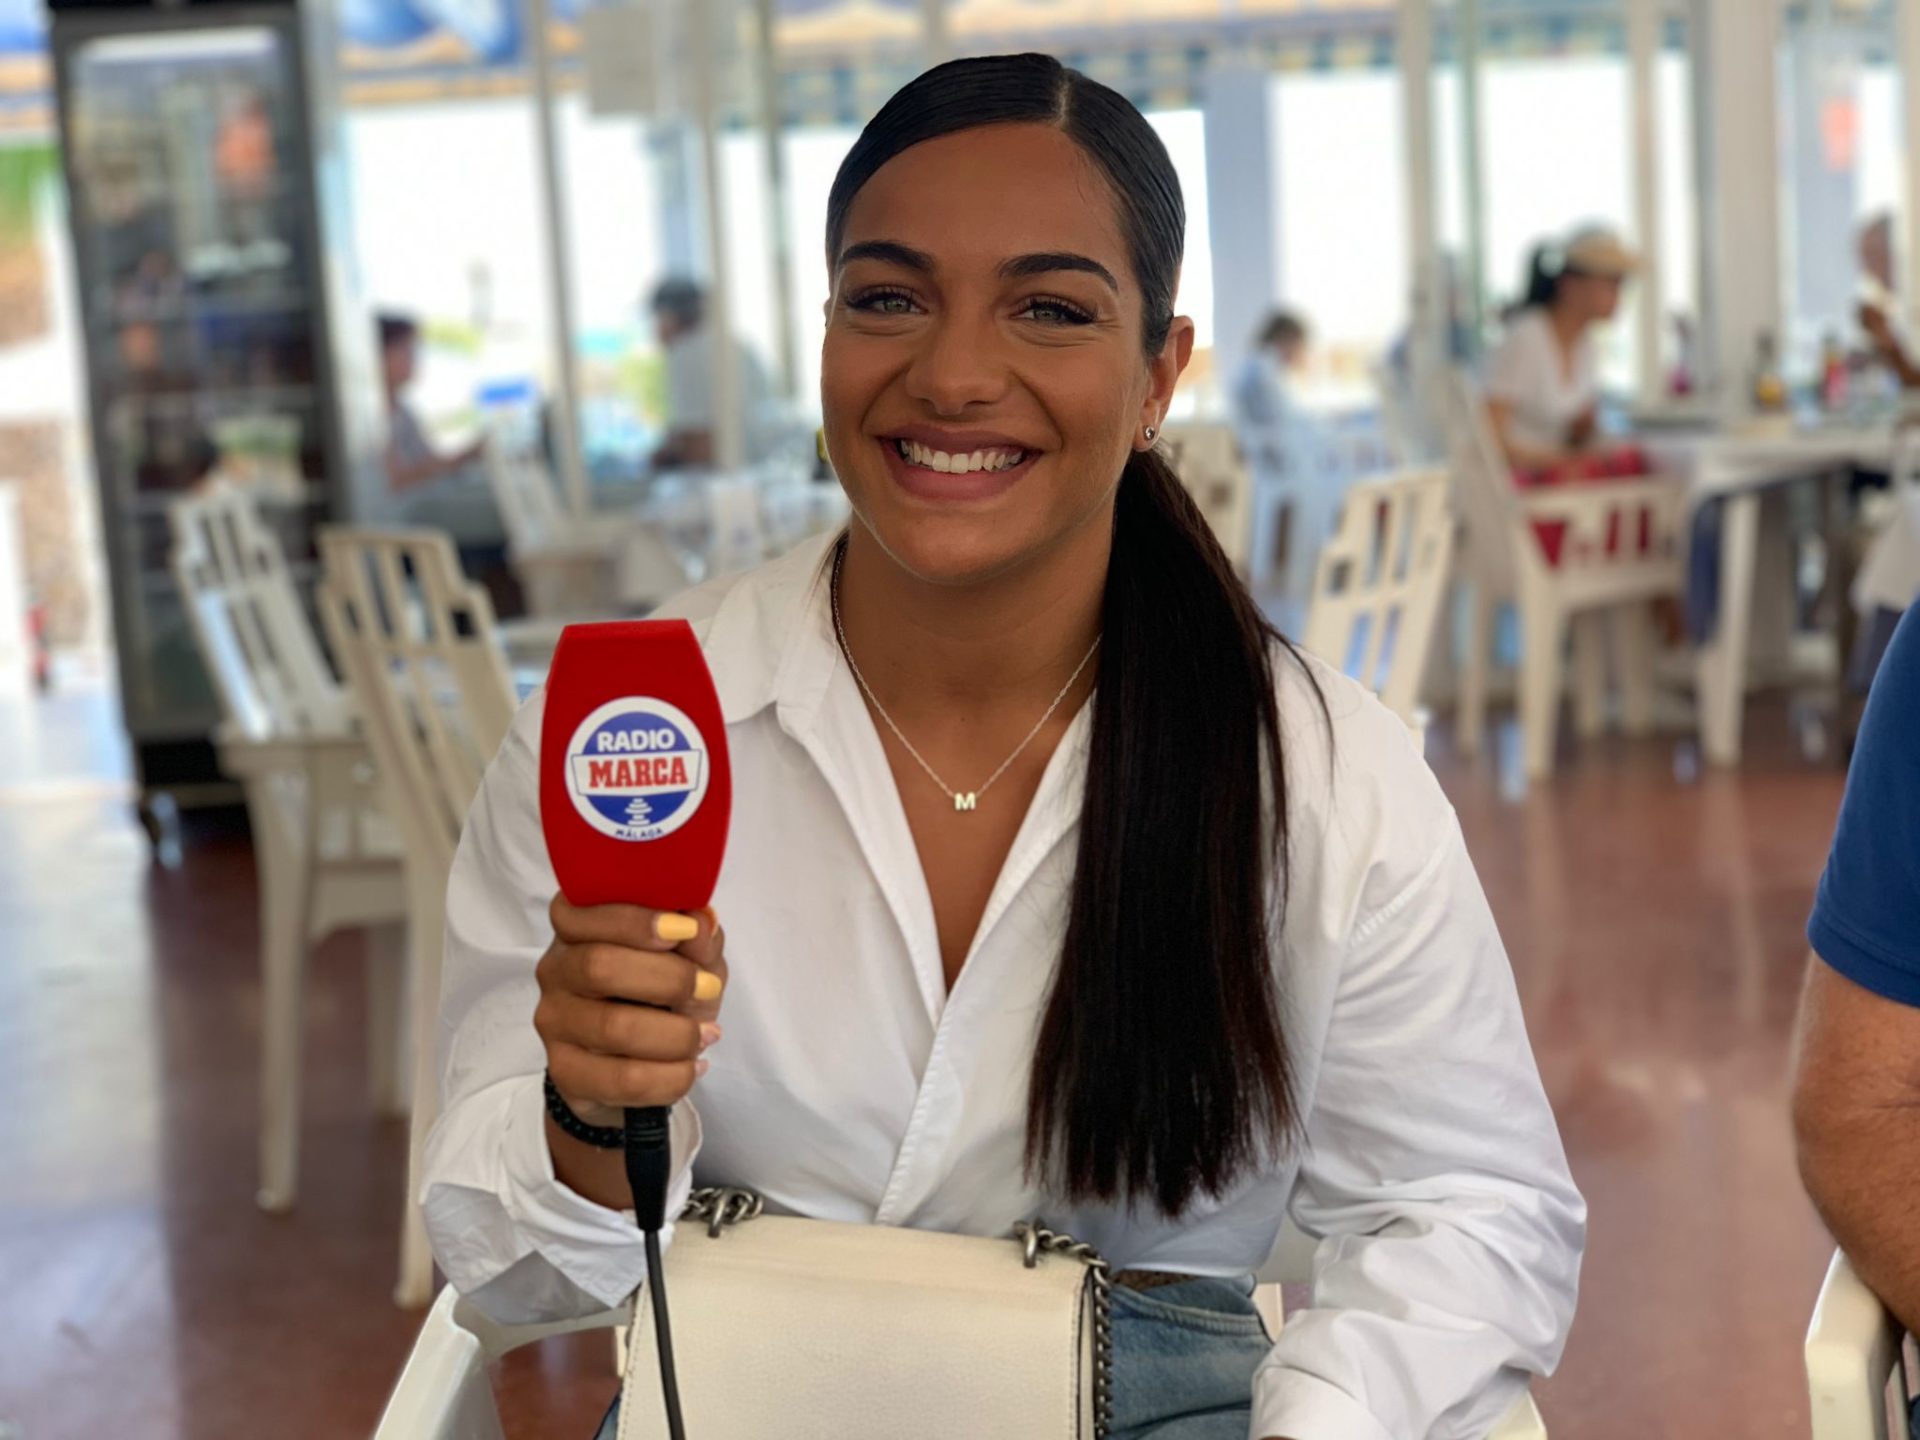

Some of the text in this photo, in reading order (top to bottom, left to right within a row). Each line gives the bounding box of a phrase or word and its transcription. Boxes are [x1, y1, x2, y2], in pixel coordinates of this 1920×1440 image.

[597, 728, 676, 752] RADIO
[588, 756, 688, 788] MARCA
[955, 792, 976, 811] M
